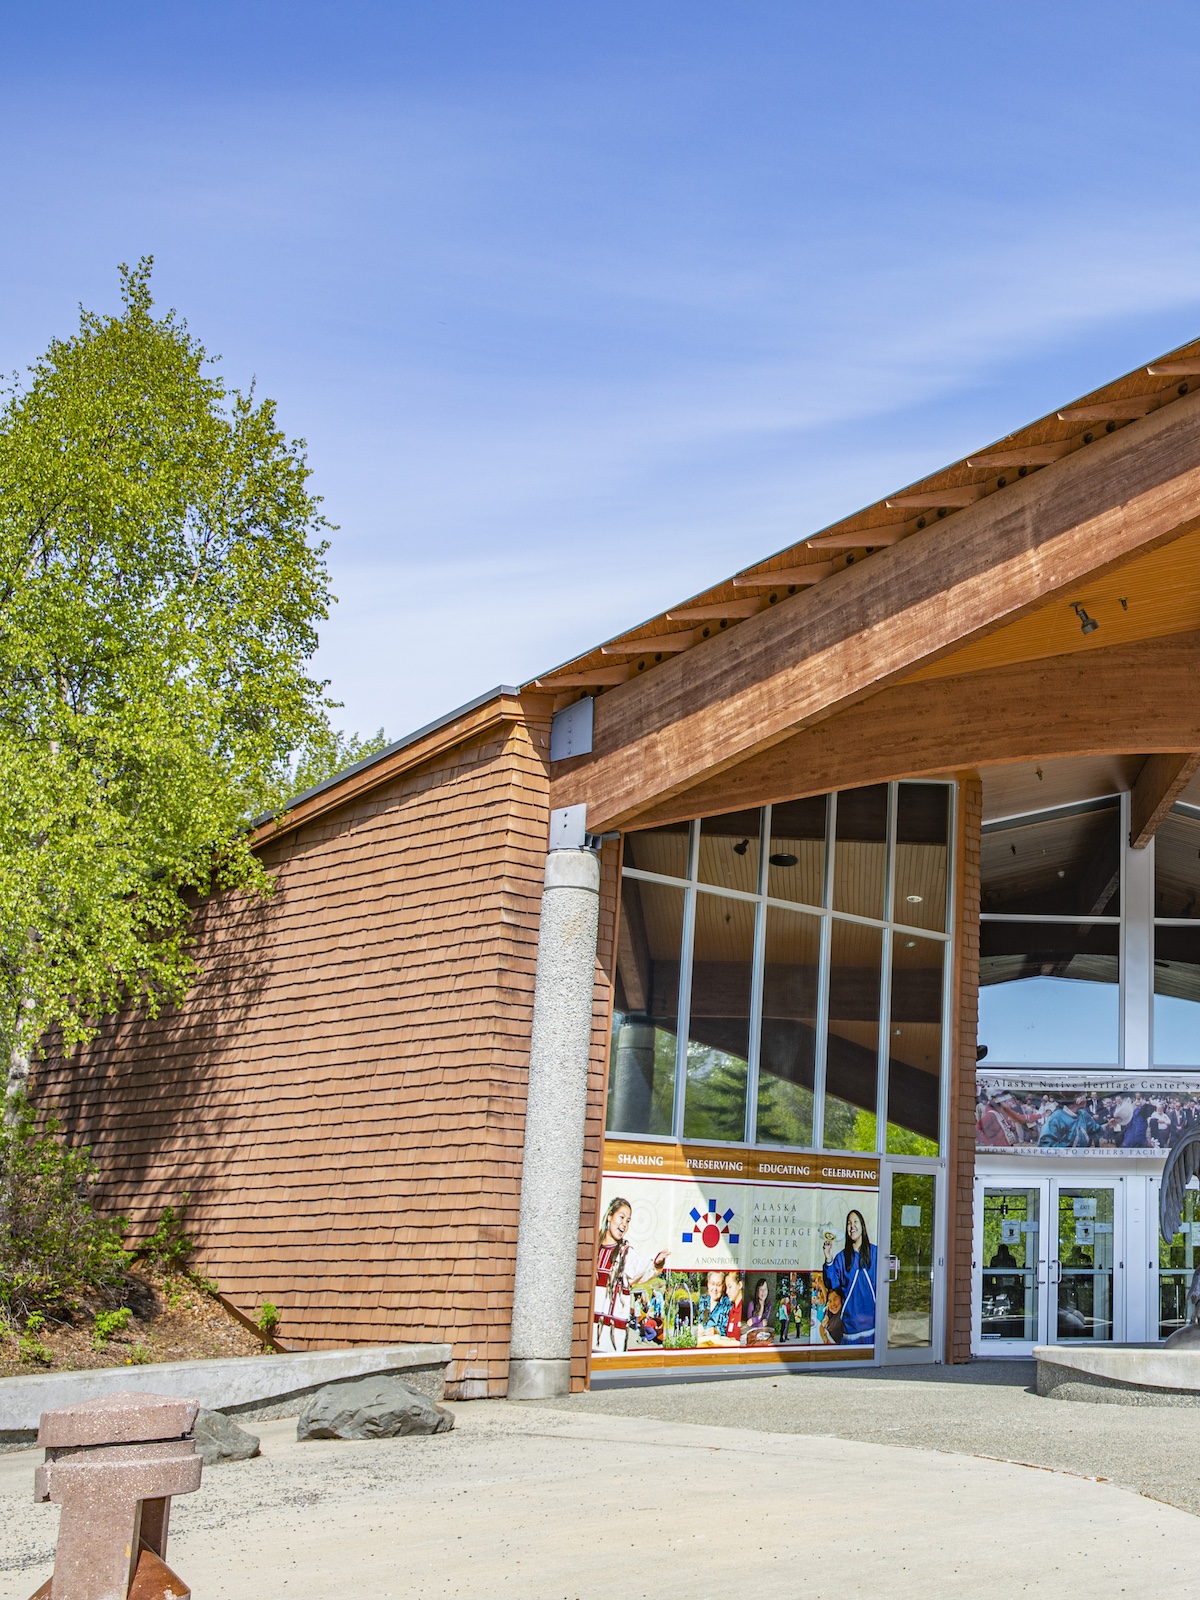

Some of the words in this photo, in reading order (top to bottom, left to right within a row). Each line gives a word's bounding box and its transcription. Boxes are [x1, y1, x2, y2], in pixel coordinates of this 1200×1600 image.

[1040, 1081, 1077, 1089] Native
[1084, 1080, 1135, 1091] Heritage
[1141, 1081, 1190, 1090] Center's
[617, 1153, 664, 1167] SHARING
[686, 1158, 743, 1172] PRESERVING
[758, 1163, 810, 1176] EDUCATING
[821, 1167, 877, 1180] CELEBRATING
[754, 1203, 797, 1212] ALASKA
[753, 1215, 796, 1224] NATIVE
[753, 1227, 811, 1236] HERITAGE
[752, 1239, 798, 1248] CENTER
[701, 1257, 739, 1265] NONPROFIT
[752, 1258, 799, 1266] ORGANIZATION
